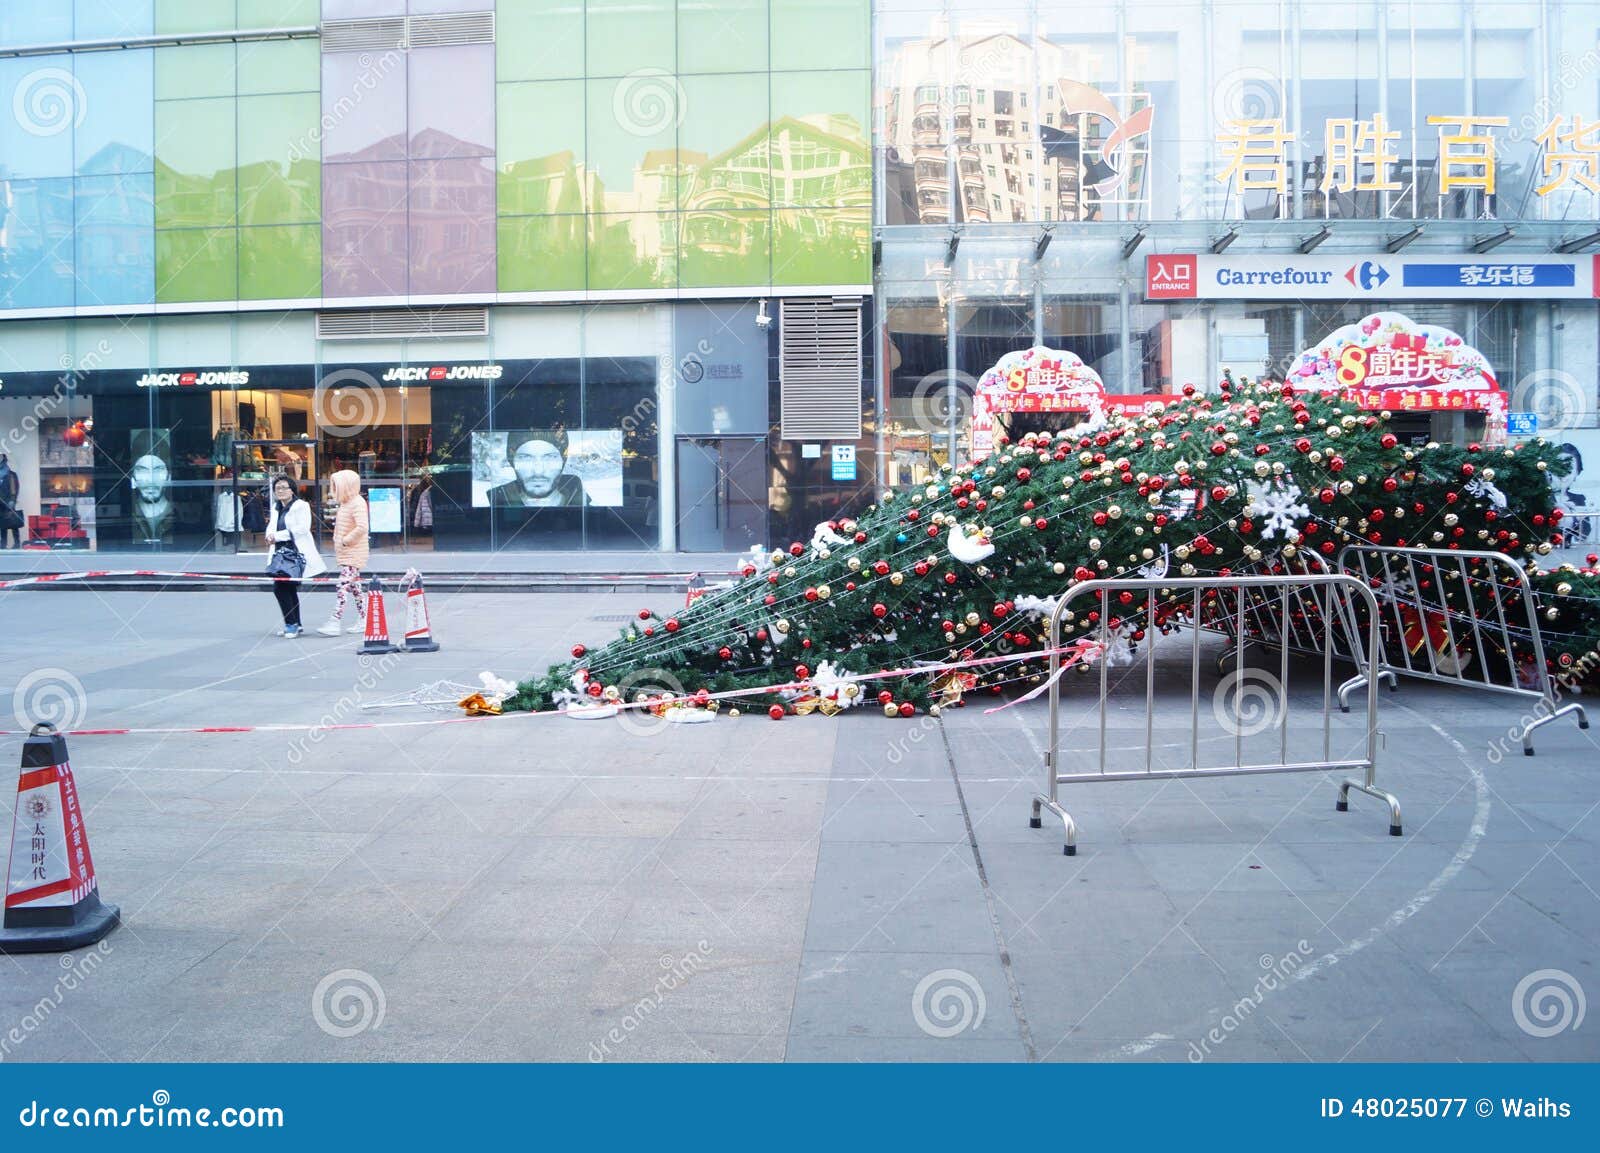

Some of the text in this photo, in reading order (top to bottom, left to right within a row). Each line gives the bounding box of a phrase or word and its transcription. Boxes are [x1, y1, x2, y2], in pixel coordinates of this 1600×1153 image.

[1216, 113, 1600, 196] 君胜百货
[1152, 262, 1190, 281] 入口
[1216, 267, 1333, 286] Carrefour
[1460, 265, 1535, 286] 家乐福
[1152, 283, 1190, 291] ENTRANCE
[136, 373, 180, 387] JACK
[195, 371, 249, 385] JONES
[382, 367, 429, 381] JACK
[446, 366, 503, 379] JONES
[31, 822, 46, 881] 太阳时代
